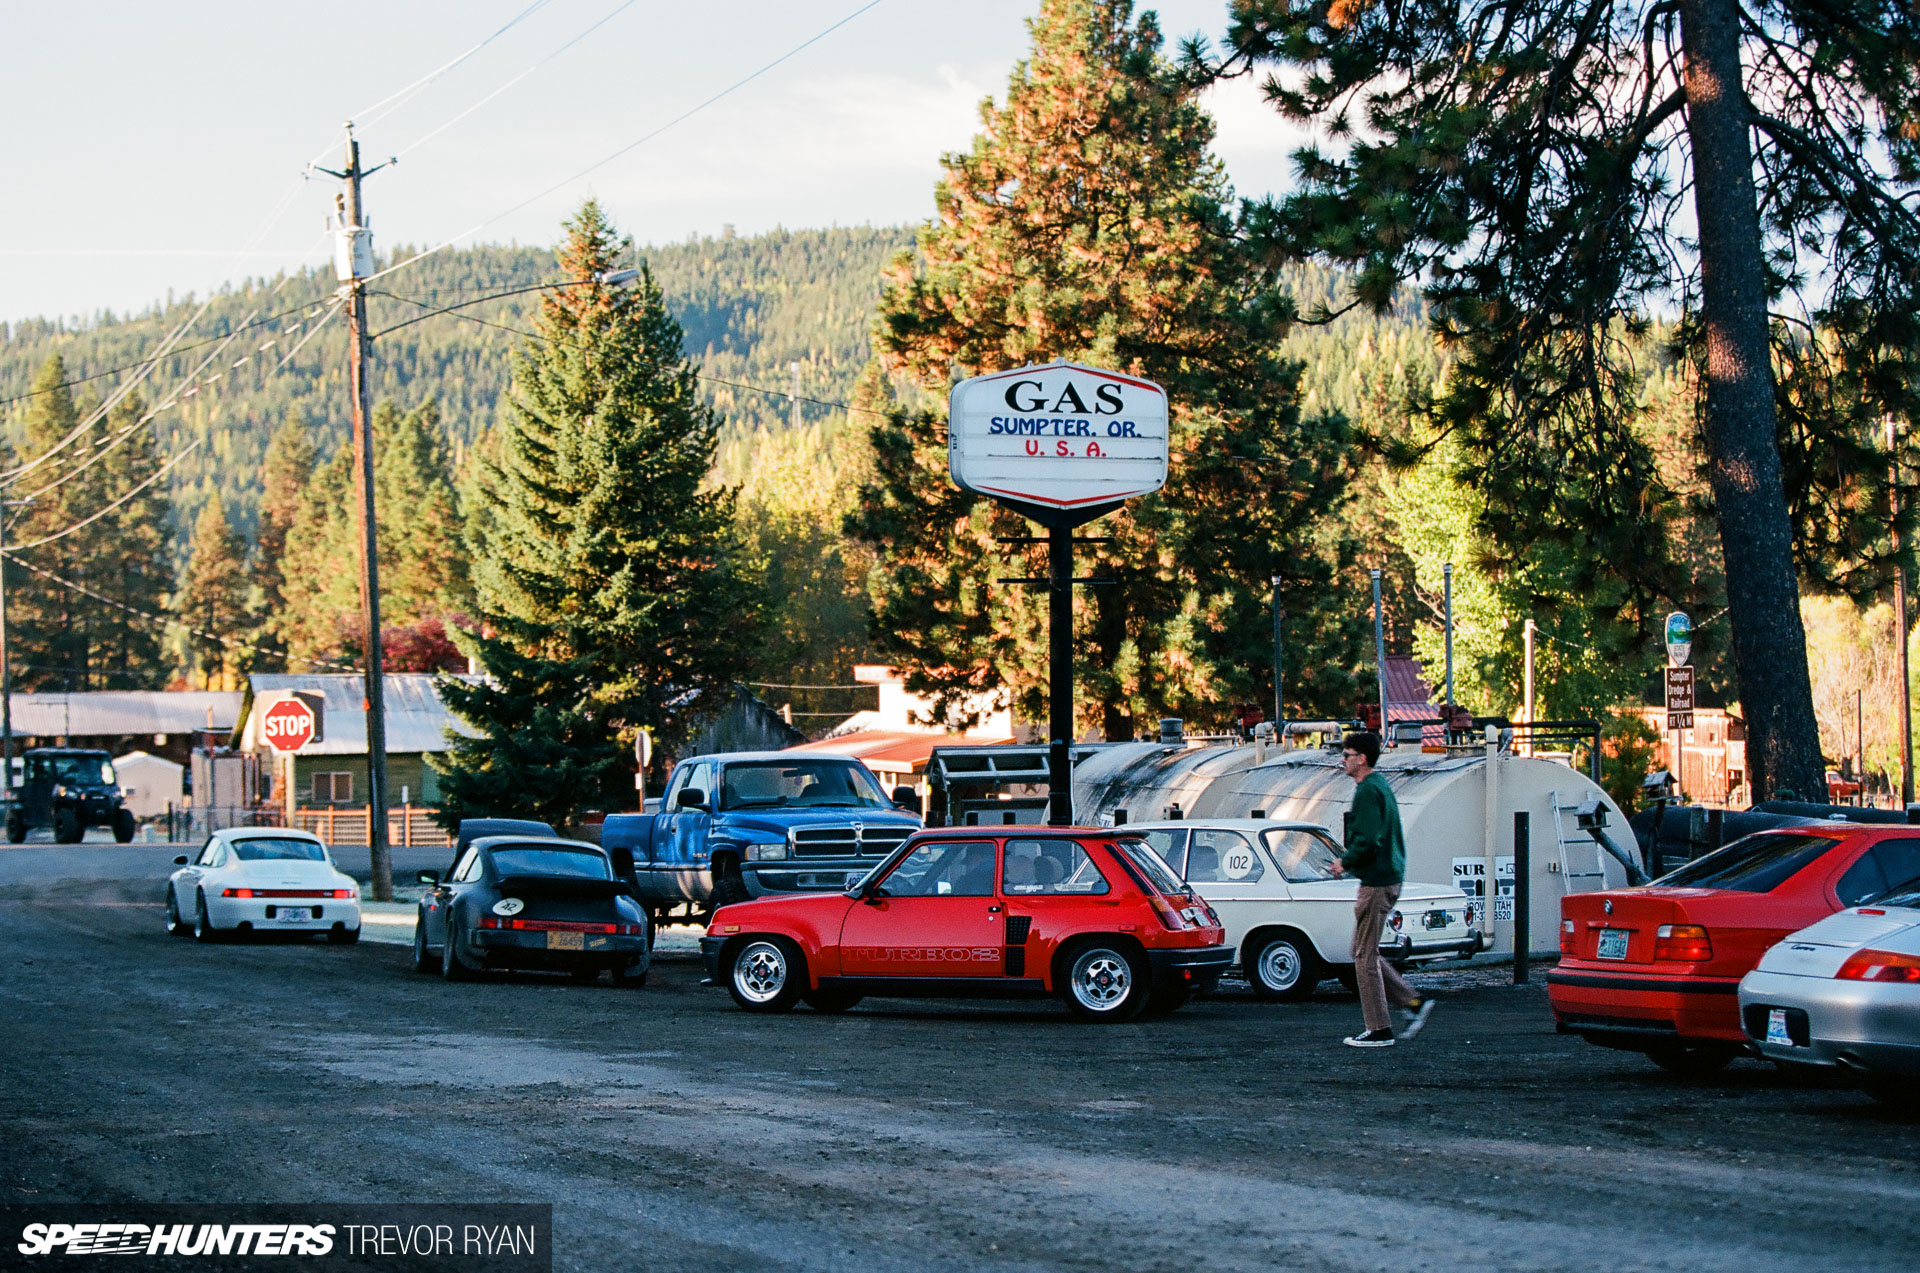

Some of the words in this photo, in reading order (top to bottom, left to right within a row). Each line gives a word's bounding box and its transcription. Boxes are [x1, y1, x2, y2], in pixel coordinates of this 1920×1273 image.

[1005, 380, 1124, 415] GAS
[1107, 421, 1142, 438] OR.
[1670, 671, 1690, 683] Sumpter
[1668, 684, 1684, 697] Dredge
[1671, 698, 1690, 709] Railroad
[266, 715, 310, 737] STOP
[1229, 856, 1248, 869] 102
[1453, 864, 1485, 876] SUR
[501, 902, 517, 911] 42
